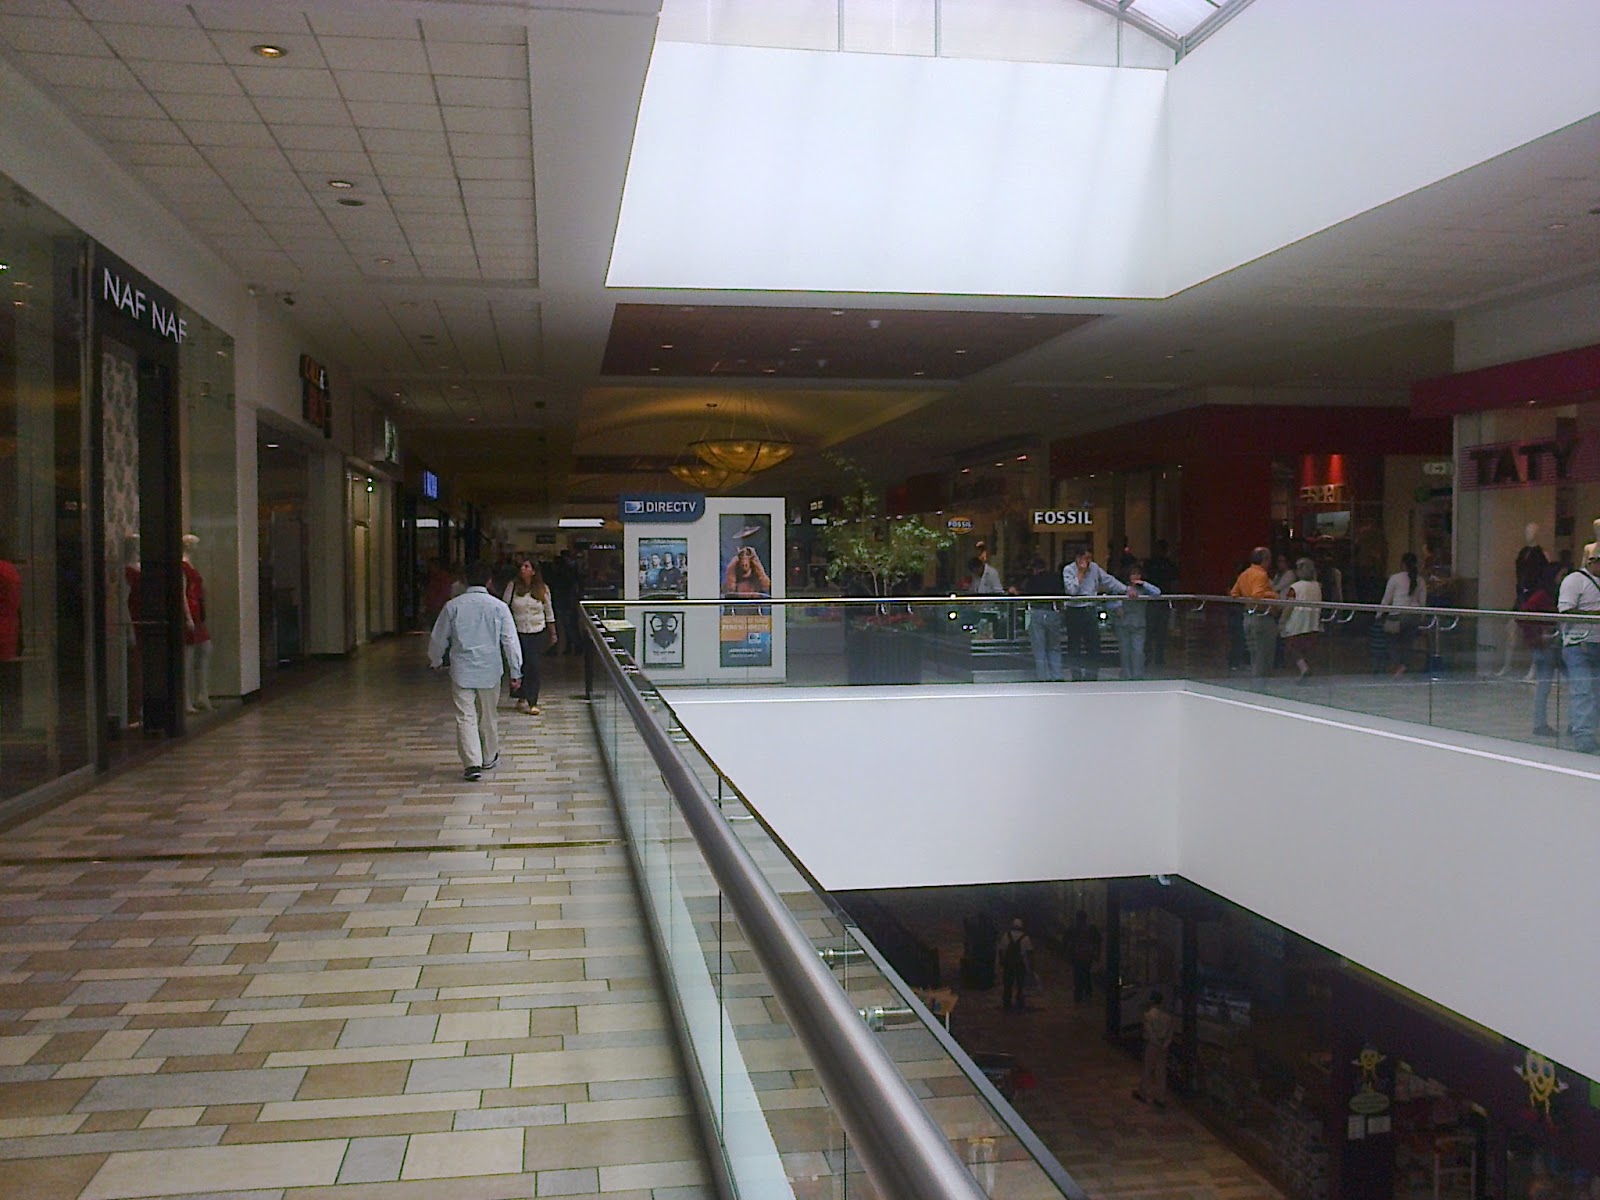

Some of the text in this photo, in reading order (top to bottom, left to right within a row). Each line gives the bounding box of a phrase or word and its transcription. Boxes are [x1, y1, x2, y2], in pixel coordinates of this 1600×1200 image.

[103, 267, 187, 344] NAF NAF
[1469, 439, 1580, 485] TATY
[646, 501, 697, 513] DIRECTV
[1034, 511, 1093, 525] FOSSIL
